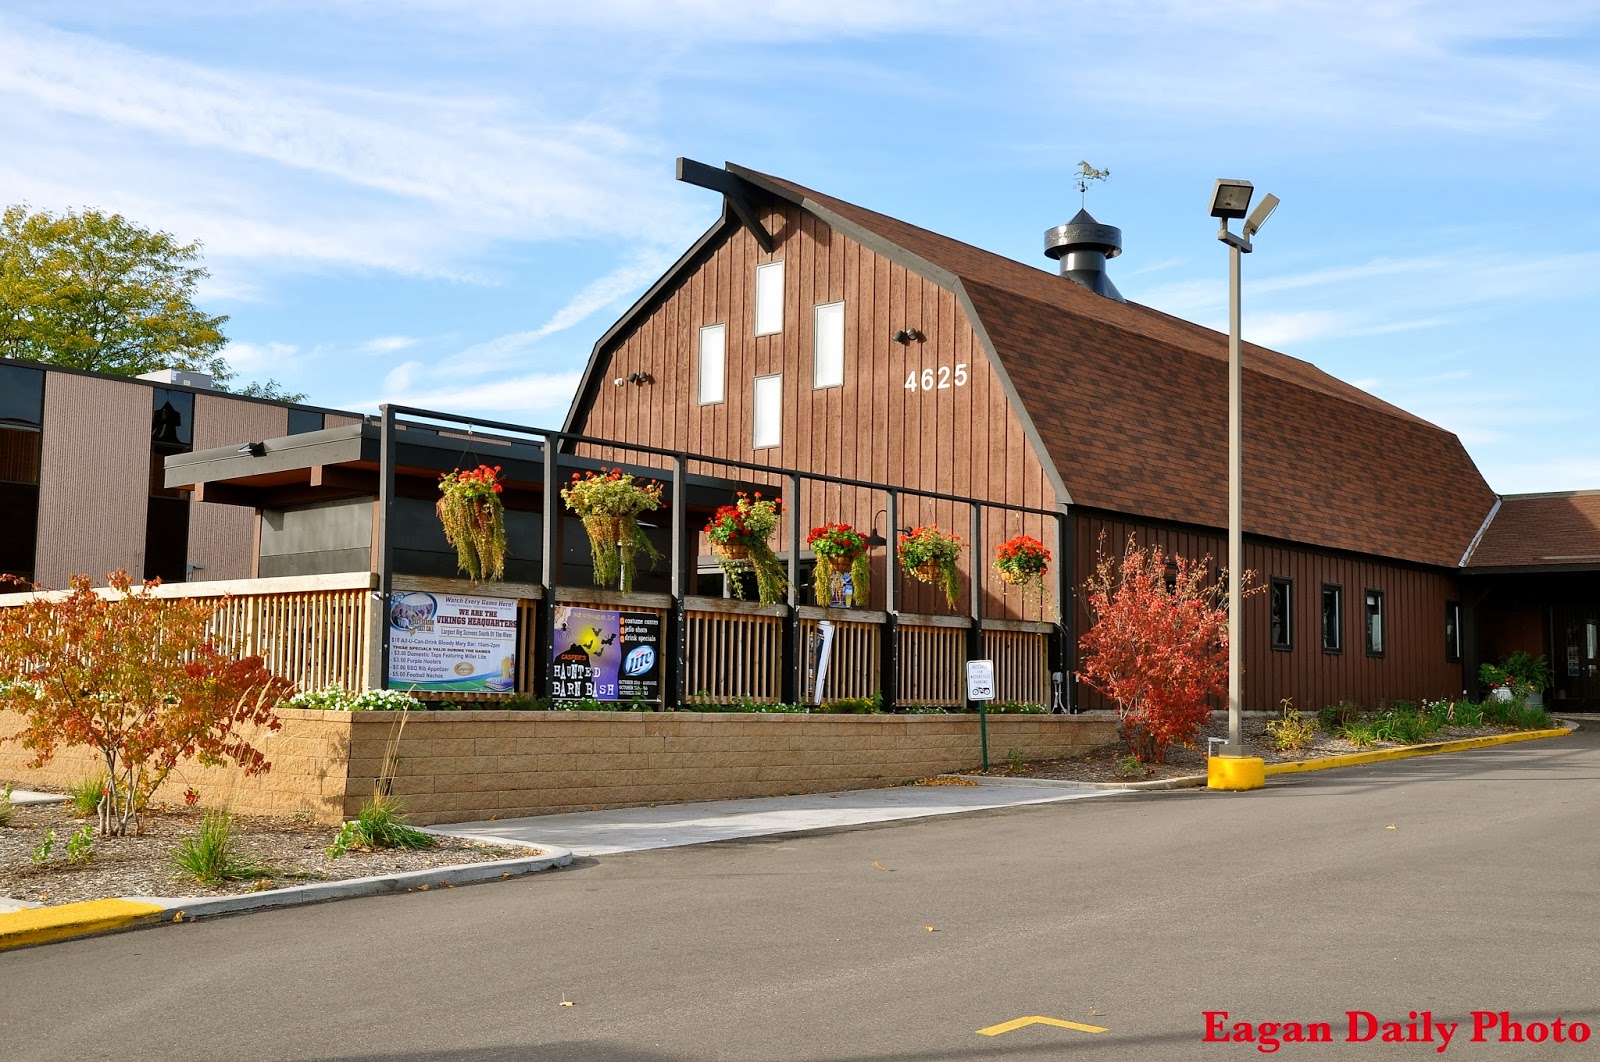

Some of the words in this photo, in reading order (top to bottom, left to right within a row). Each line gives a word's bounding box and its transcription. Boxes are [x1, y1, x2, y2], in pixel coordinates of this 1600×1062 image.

[904, 364, 968, 392] 4625
[464, 598, 480, 606] Every
[481, 599, 498, 607] Game
[498, 600, 514, 608] Here!
[458, 608, 470, 616] WE
[470, 609, 483, 617] ARE
[484, 610, 498, 618] THE
[436, 615, 467, 625] VIKINGS
[624, 617, 643, 625] costume
[624, 626, 635, 634] jello
[635, 626, 647, 634] shots
[629, 651, 652, 673] Lite
[553, 663, 601, 679] HAUNTED
[552, 680, 582, 697] BARN
[585, 681, 615, 697] BASH
